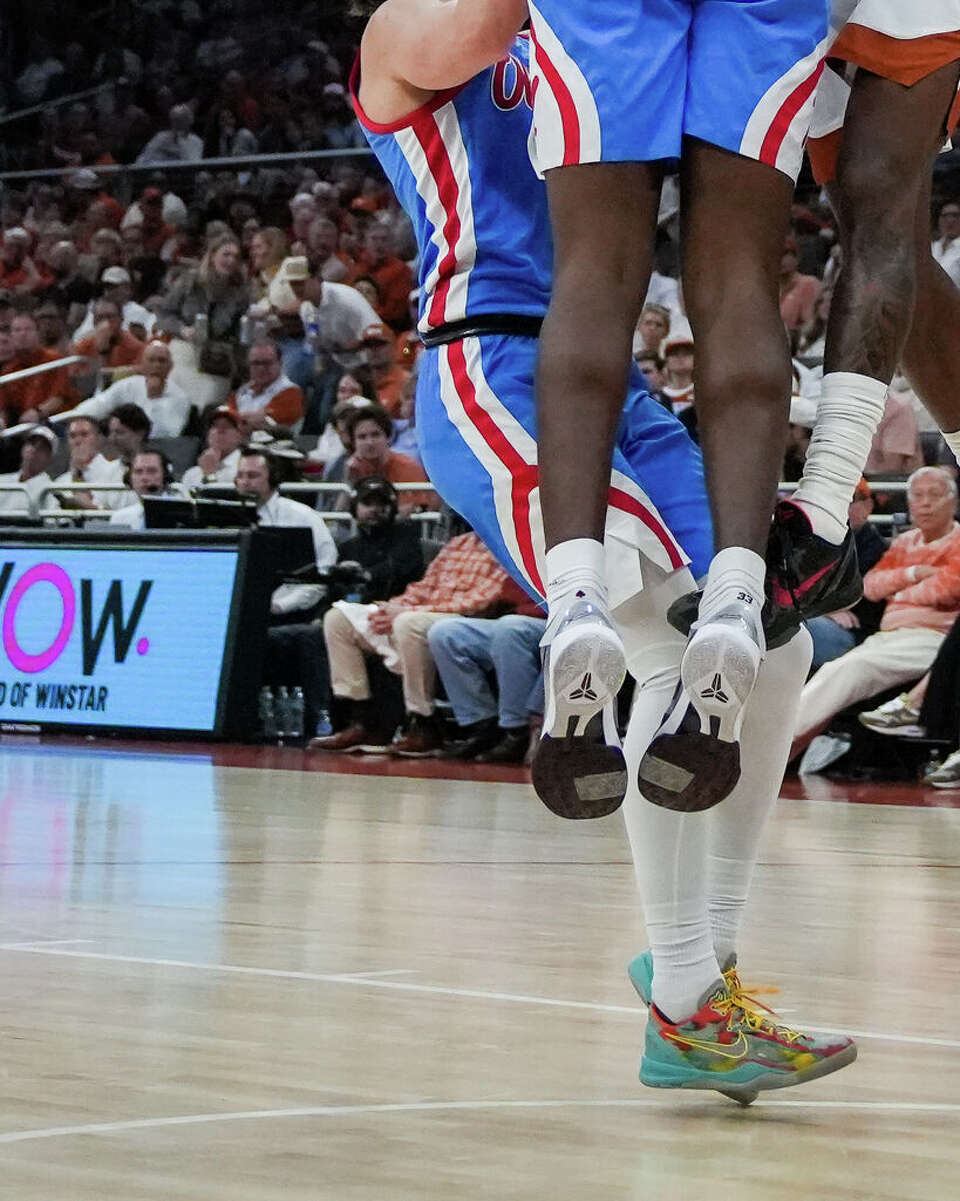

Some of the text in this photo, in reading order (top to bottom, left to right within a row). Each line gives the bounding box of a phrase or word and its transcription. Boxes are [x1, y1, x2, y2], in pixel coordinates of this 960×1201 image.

[737, 591, 753, 604] 33
[10, 681, 32, 708] OF
[36, 683, 108, 711] WINSTAR
